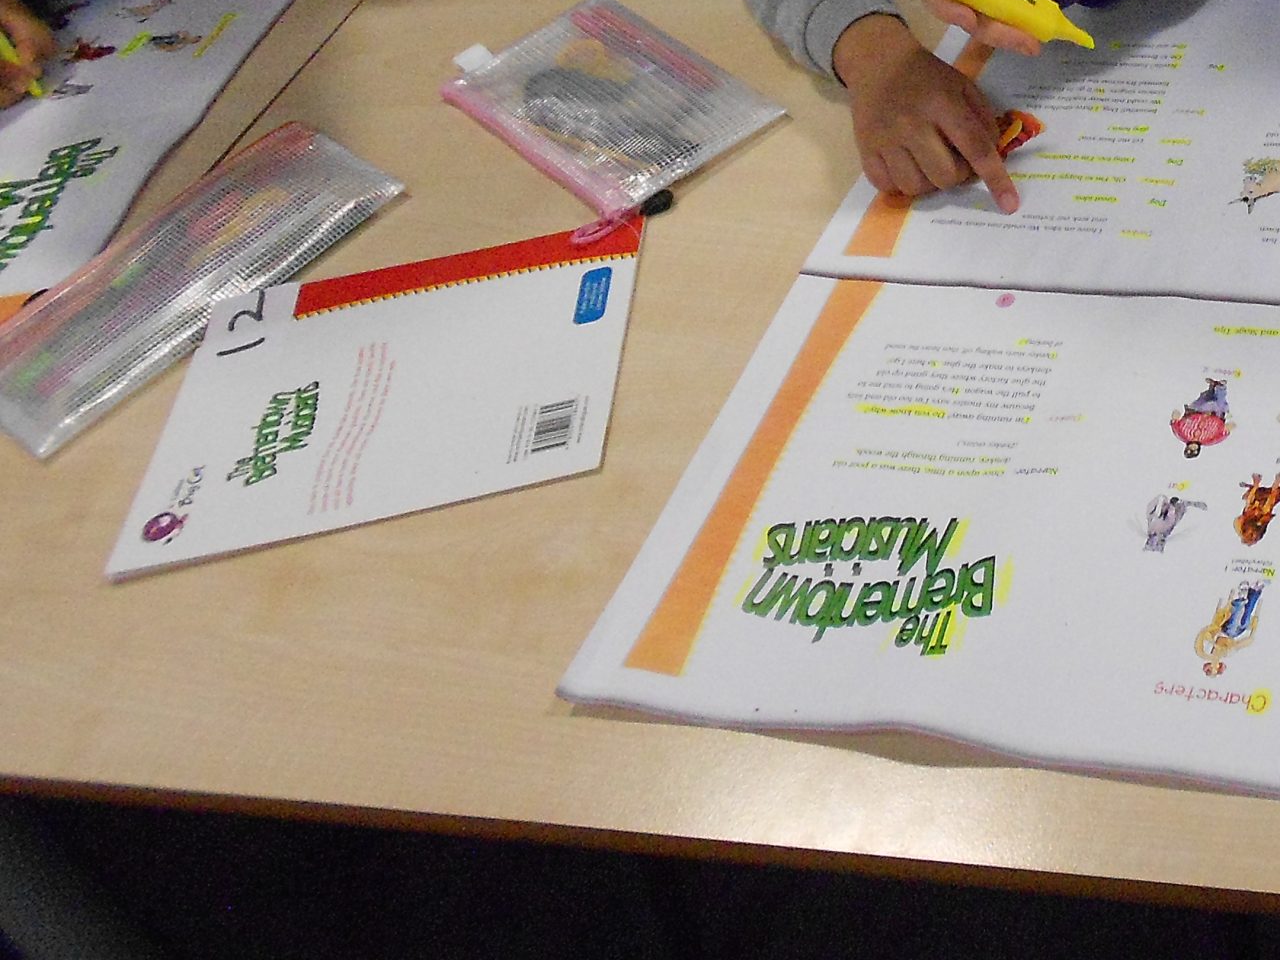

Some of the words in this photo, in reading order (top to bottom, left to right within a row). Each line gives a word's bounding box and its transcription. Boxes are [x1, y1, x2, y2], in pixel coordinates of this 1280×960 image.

[216, 289, 266, 357] 12
[1260, 329, 1279, 337] and
[977, 414, 1012, 422] running
[901, 452, 936, 461] through
[939, 455, 975, 463] running
[226, 455, 254, 482] The
[898, 466, 920, 474] there
[957, 469, 980, 477] upon
[763, 516, 958, 577] Musicians
[1232, 566, 1275, 577] Narrator
[741, 555, 995, 644] Brementown
[894, 610, 952, 657] The
[1153, 681, 1267, 713] Characters
